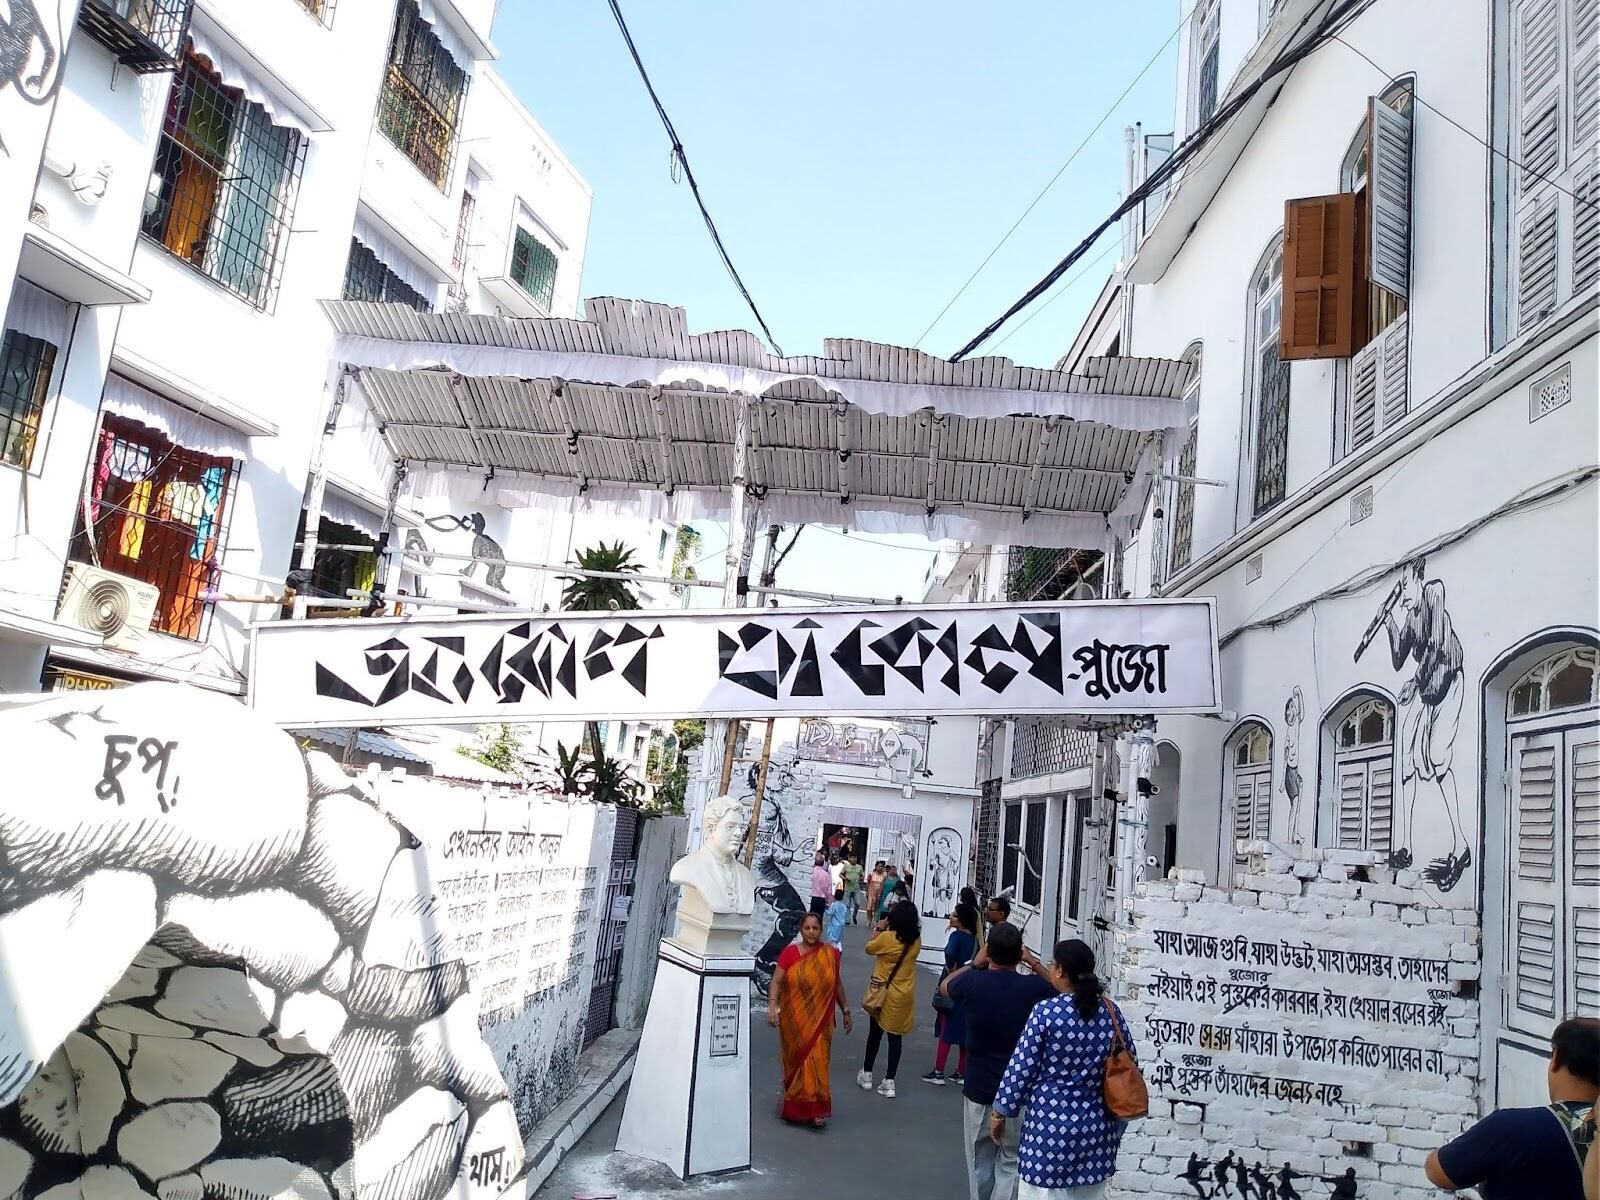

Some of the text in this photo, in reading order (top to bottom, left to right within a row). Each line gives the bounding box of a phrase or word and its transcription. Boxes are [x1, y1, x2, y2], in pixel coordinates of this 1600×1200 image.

[1153, 930, 1182, 955] যাহা
[1251, 942, 1278, 966] যাহা
[1317, 949, 1345, 973] যাহা
[1398, 957, 1449, 984] তাহাদের
[1229, 969, 1272, 984] পুজোর
[1195, 975, 1217, 1004] এই
[1323, 987, 1347, 1018] ইহা
[1392, 1001, 1426, 1027] রসের
[1148, 1019, 1194, 1047] সুতরাং
[1282, 1026, 1338, 1064] উপভোগ
[1338, 1035, 1379, 1068] করিতে
[1381, 1045, 1422, 1072] পারেন
[1273, 1077, 1314, 1104] জন্য
